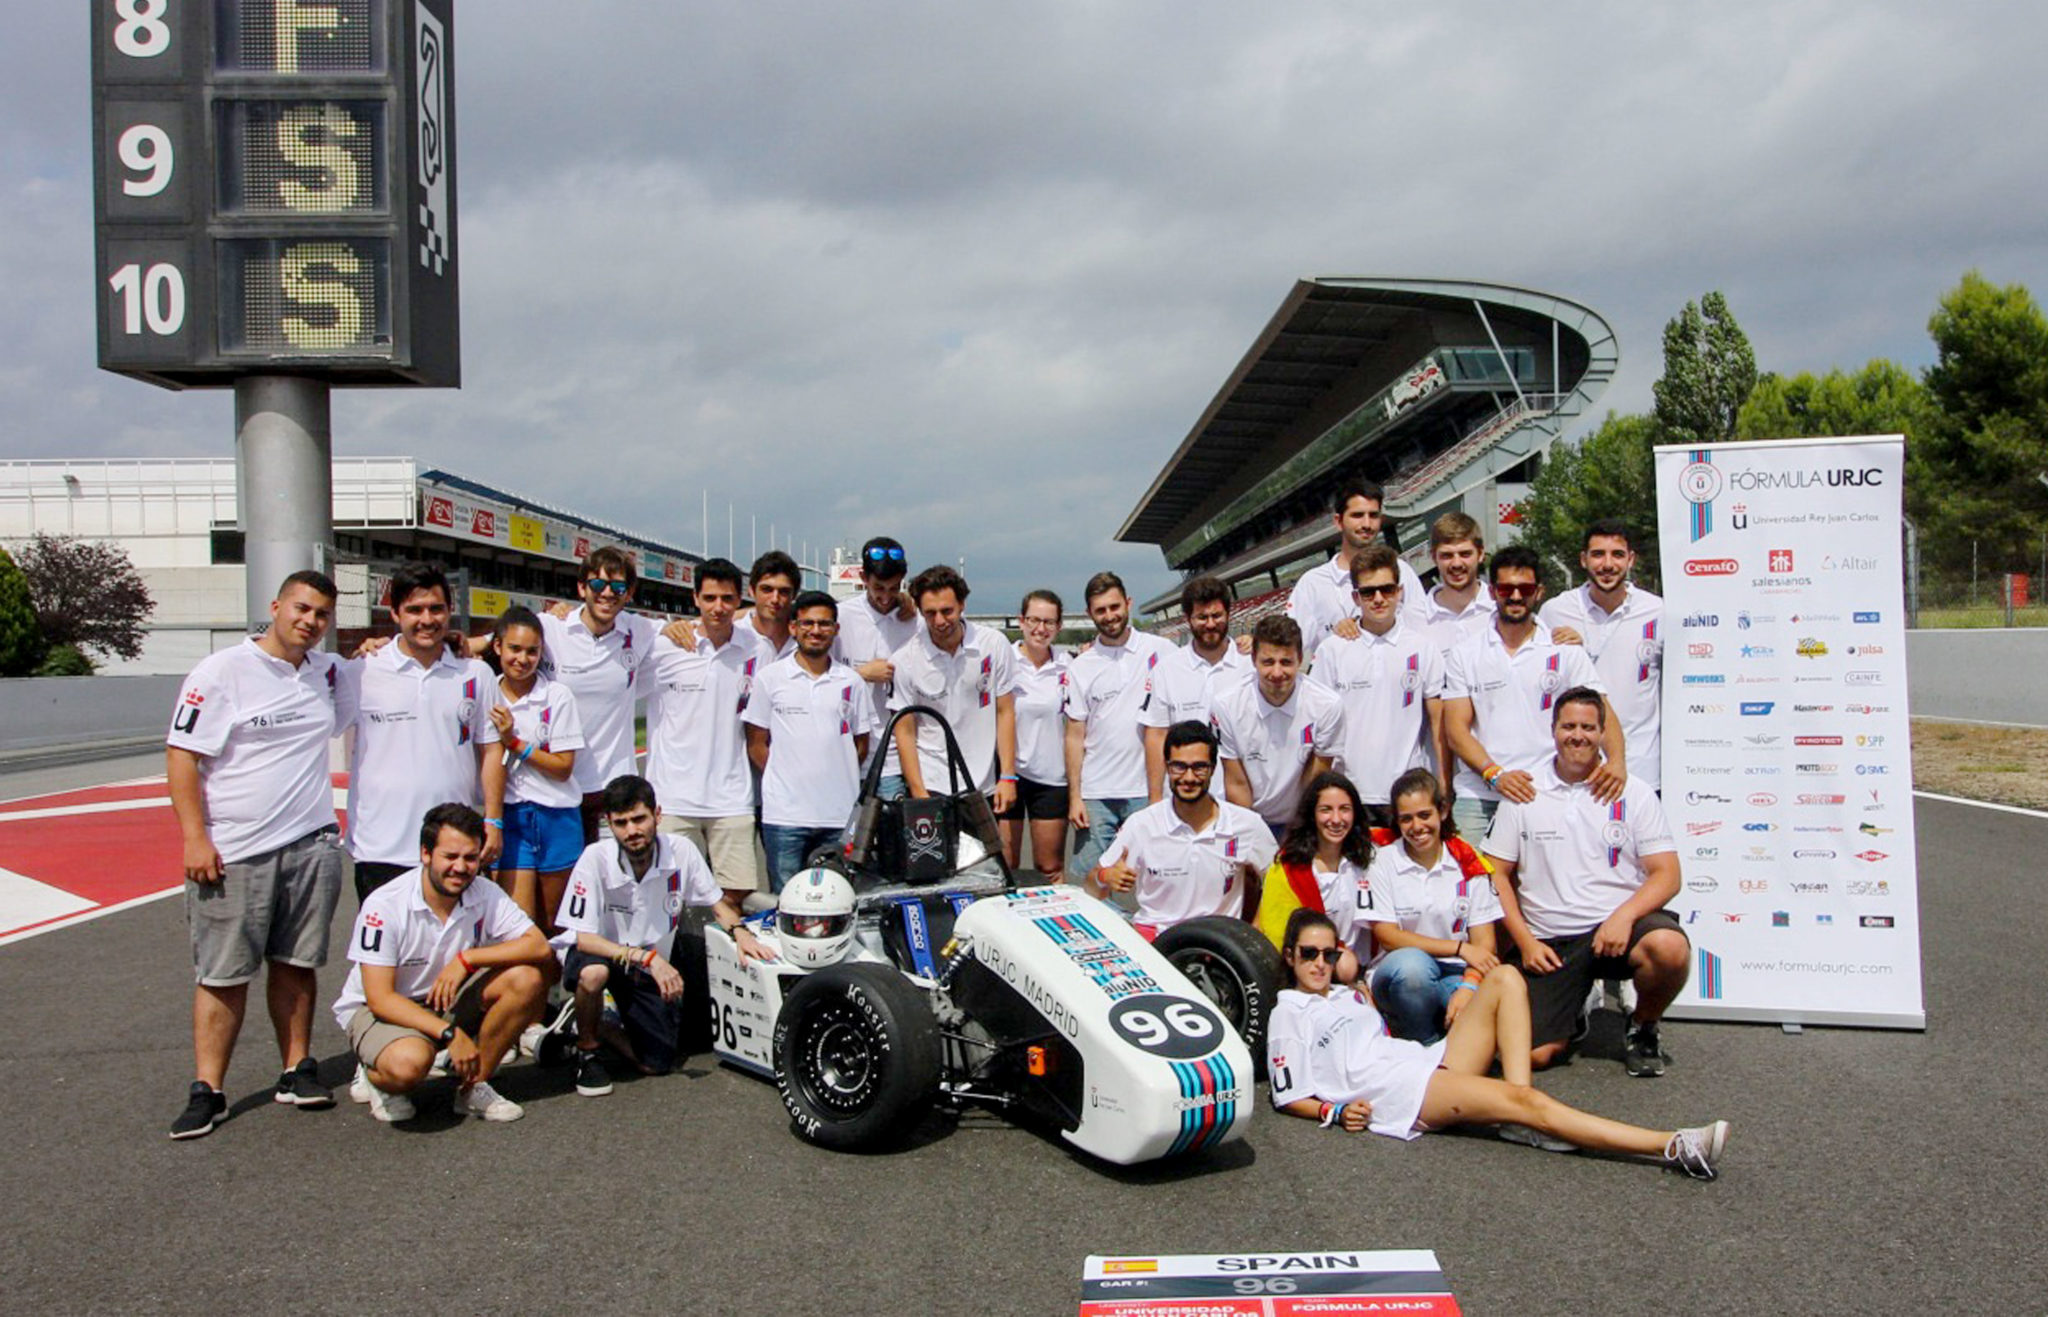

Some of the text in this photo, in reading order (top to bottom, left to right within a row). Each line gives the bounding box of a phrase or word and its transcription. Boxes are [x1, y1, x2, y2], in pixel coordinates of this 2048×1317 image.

[114, 0, 171, 57] 8
[117, 124, 174, 197] 9
[277, 105, 357, 212] S
[108, 262, 186, 335] 10
[280, 242, 361, 349] S
[1730, 467, 1823, 490] FÓRMULA
[1827, 468, 1882, 487] URJC
[1753, 514, 1806, 525] Universidad
[1809, 513, 1825, 524] Rey
[1827, 513, 1847, 524] Juan
[1849, 512, 1879, 522] Carlos
[1842, 555, 1877, 570] Altair
[1752, 575, 1812, 587] salesianos
[1740, 960, 1893, 976] www.formulaurjc.com
[980, 941, 1080, 1039] URJC MADRID
[1103, 977, 1157, 994] aluNID
[711, 997, 737, 1050] 96
[1119, 1003, 1214, 1046] 96
[1217, 1256, 1360, 1271] SPAIN
[1100, 1280, 1133, 1288] CAR
[1233, 1277, 1297, 1294] 96
[1115, 1306, 1235, 1315] UNIVERSIDAD
[1292, 1302, 1433, 1311] FORMULA URJC
